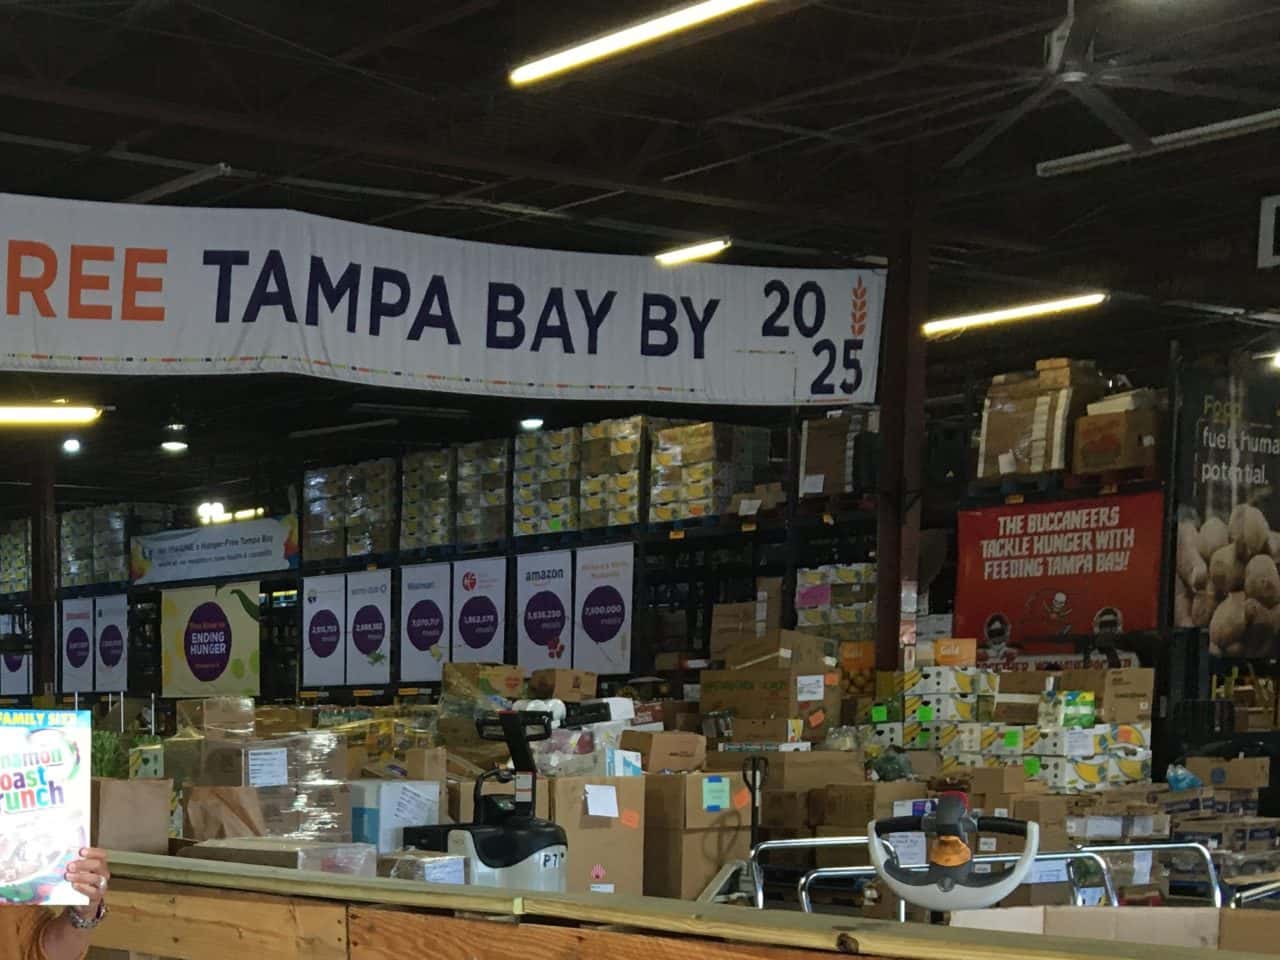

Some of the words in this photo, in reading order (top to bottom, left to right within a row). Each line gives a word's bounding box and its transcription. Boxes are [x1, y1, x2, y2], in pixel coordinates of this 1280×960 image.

[202, 249, 461, 345] TAMPA
[485, 281, 618, 354] BAY
[640, 293, 721, 359] BY
[761, 279, 826, 338] 20
[810, 338, 864, 395] 25
[998, 514, 1025, 536] THE
[1027, 506, 1120, 534] BUCCANEERS
[981, 536, 1031, 558] TACKLE
[1033, 531, 1093, 554] HUNGER
[1095, 527, 1135, 551] WITH
[526, 568, 564, 582] amazon
[984, 557, 1043, 580] FEEDING
[1047, 553, 1093, 576] TAMPA
[1096, 550, 1130, 573] BAY!
[190, 643, 227, 655] HUNGER
[191, 631, 225, 643] ENDING
